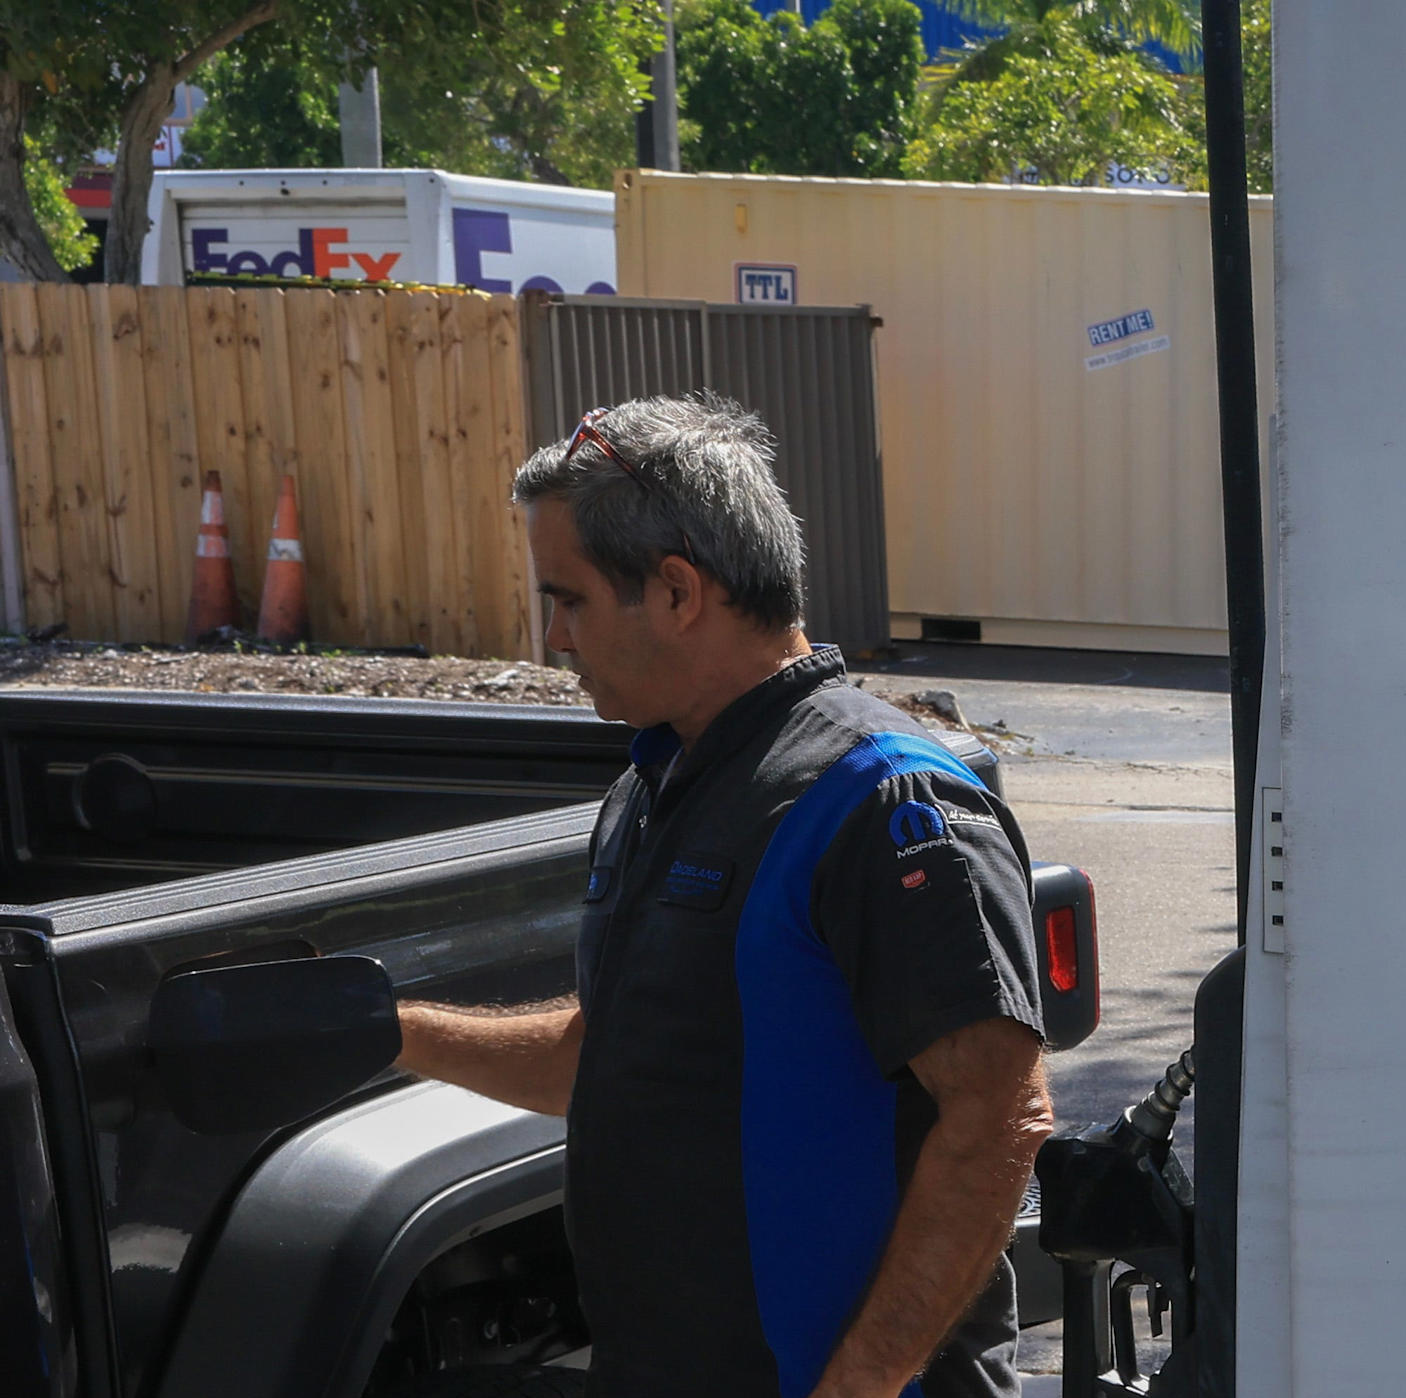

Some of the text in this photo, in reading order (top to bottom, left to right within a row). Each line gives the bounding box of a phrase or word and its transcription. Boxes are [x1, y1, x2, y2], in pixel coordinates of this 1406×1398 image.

[192, 227, 401, 282] FedEx
[744, 274, 790, 302] TTL
[1089, 312, 1153, 345] RENT ME!
